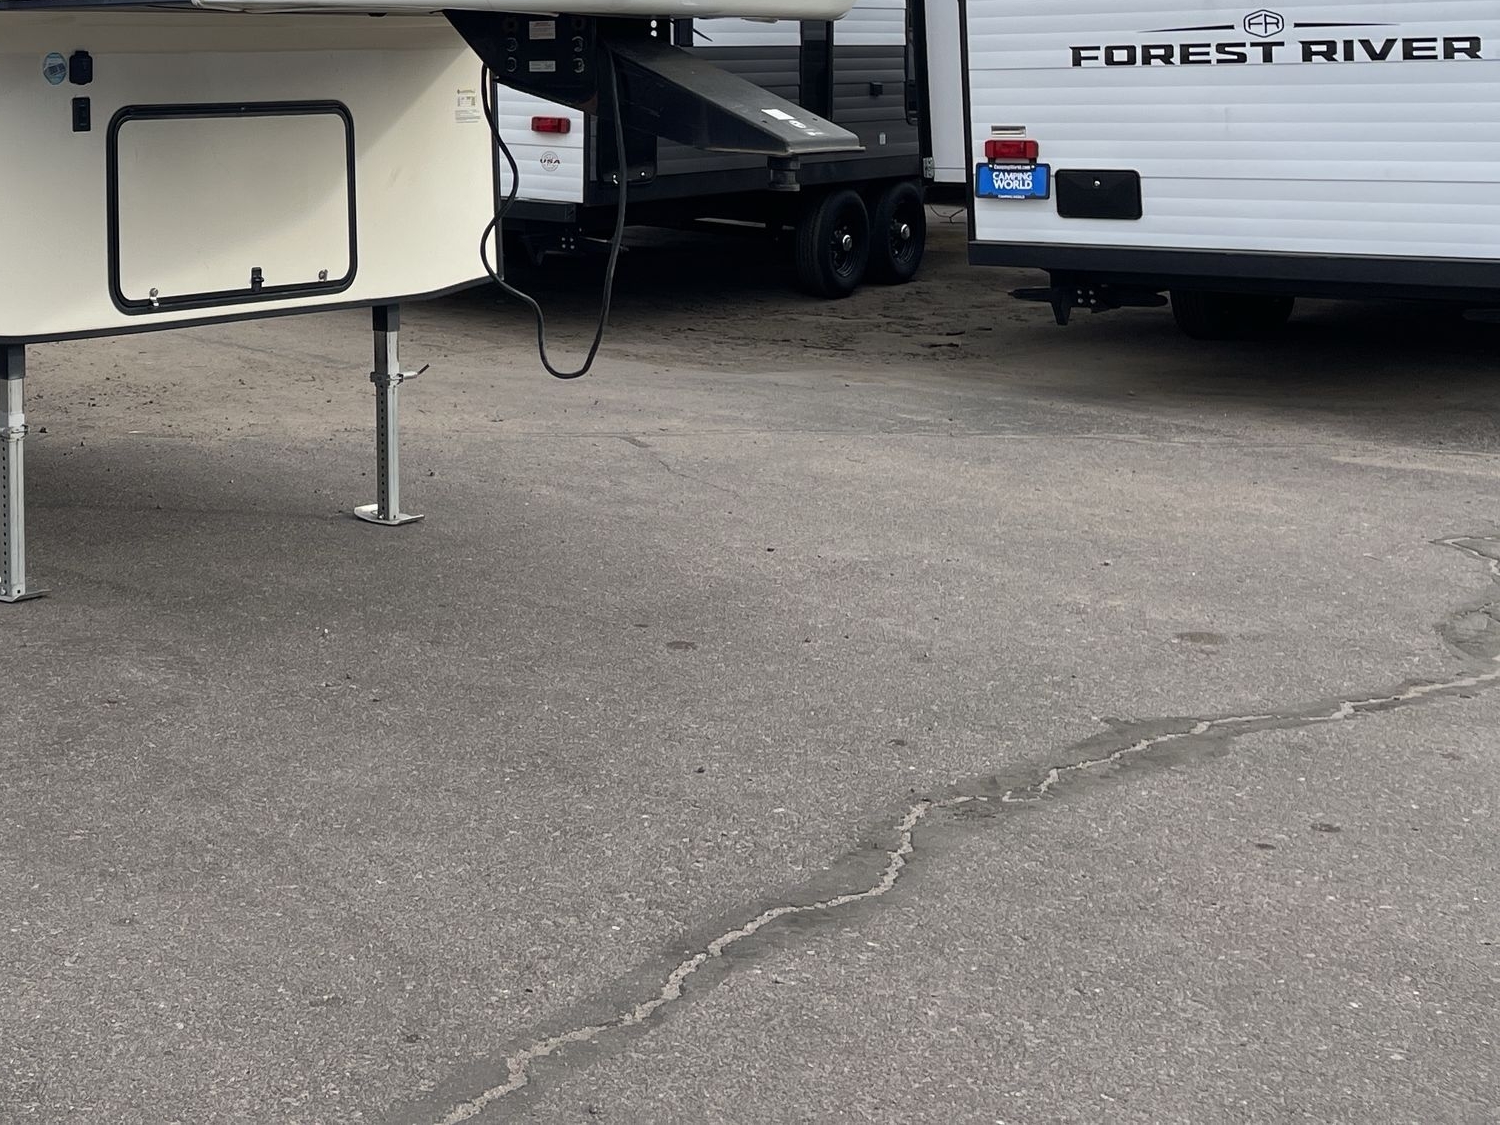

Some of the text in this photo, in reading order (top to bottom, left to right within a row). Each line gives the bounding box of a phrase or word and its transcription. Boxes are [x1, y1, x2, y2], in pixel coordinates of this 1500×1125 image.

[1069, 36, 1483, 67] FOREST RIVER
[992, 171, 1033, 181] CAMPING
[993, 179, 1033, 190] WORLD
